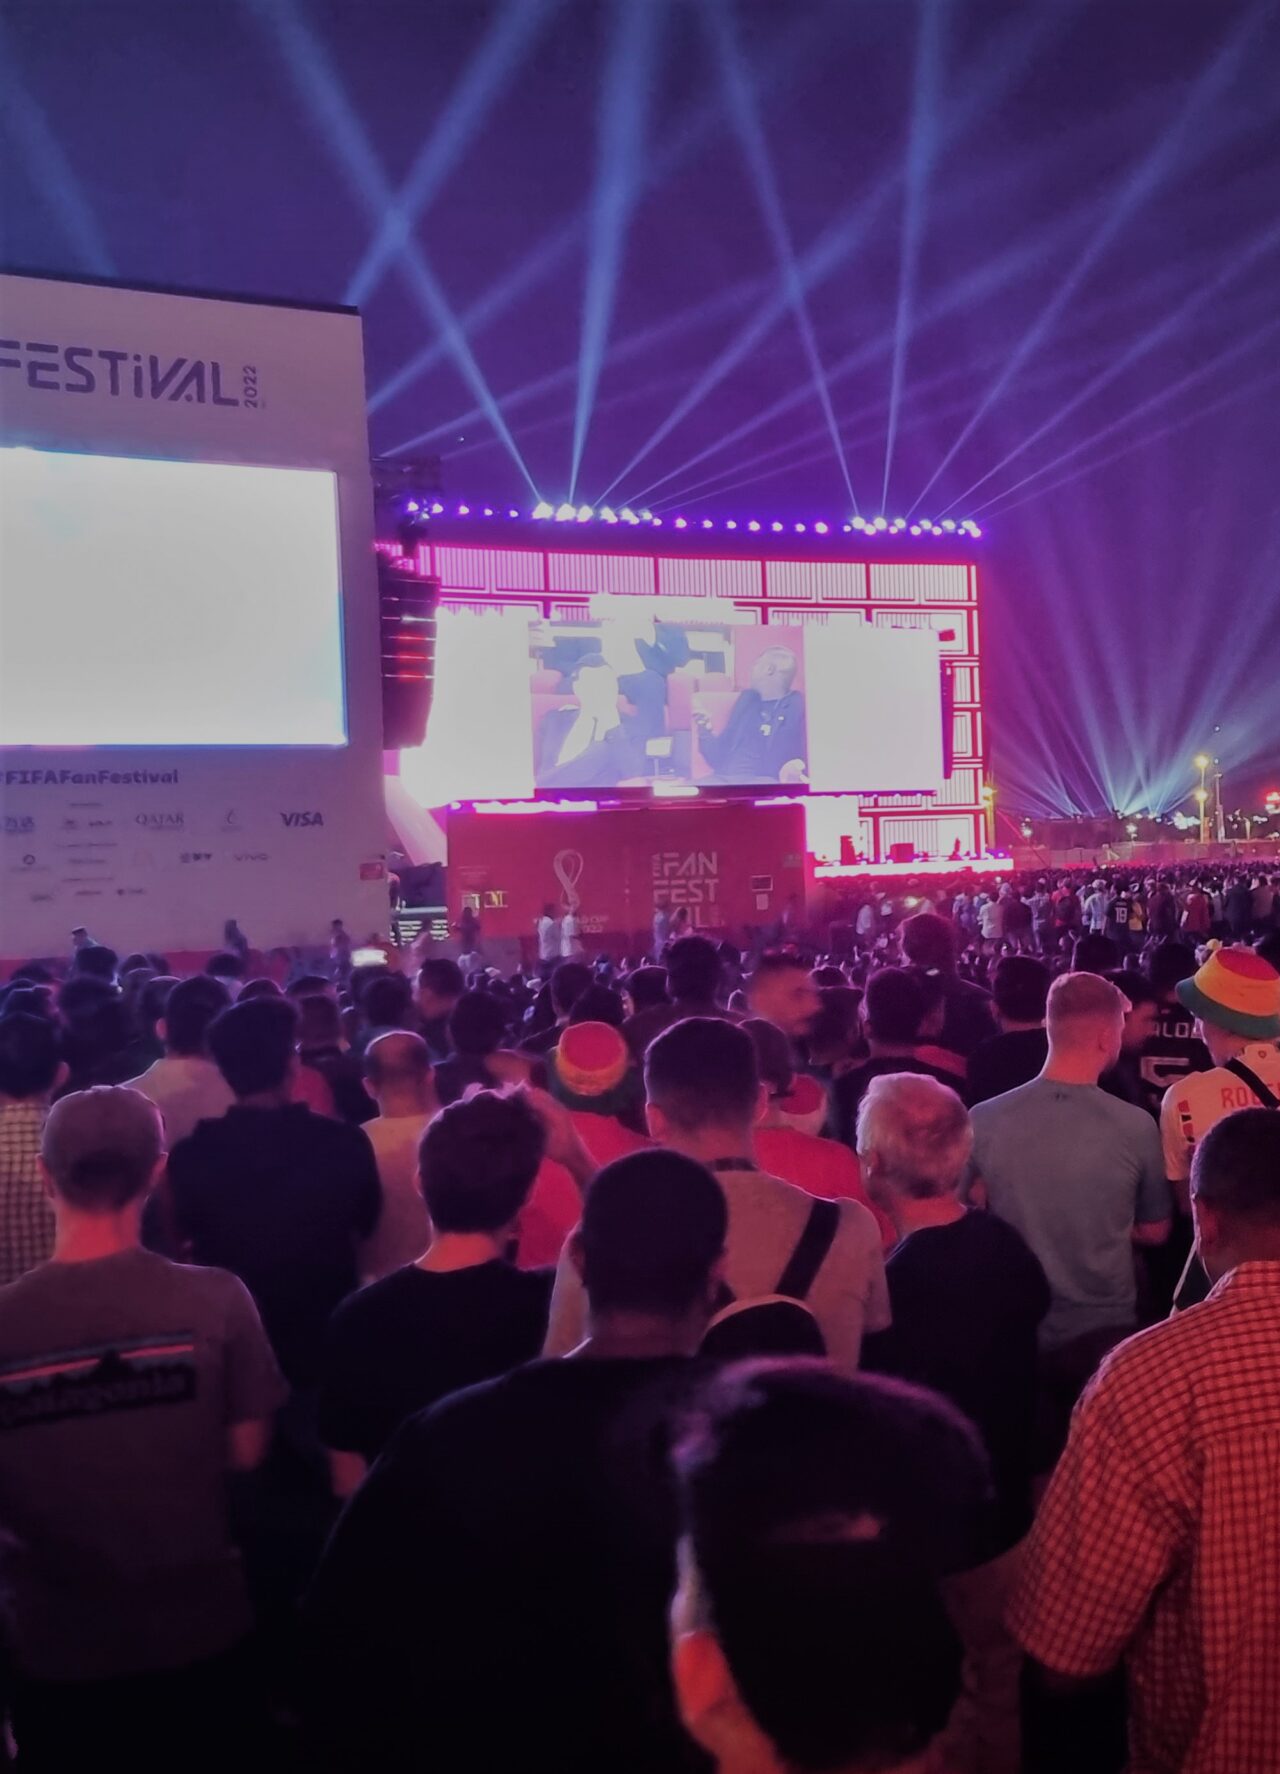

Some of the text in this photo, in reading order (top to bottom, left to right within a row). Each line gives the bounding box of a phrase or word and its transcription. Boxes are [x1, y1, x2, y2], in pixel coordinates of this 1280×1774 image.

[242, 364, 258, 409] 2022
[0, 769, 179, 785] FIFAFanFestival
[280, 811, 324, 827] VISA
[663, 851, 718, 877] FAN
[653, 878, 720, 903] FEST
